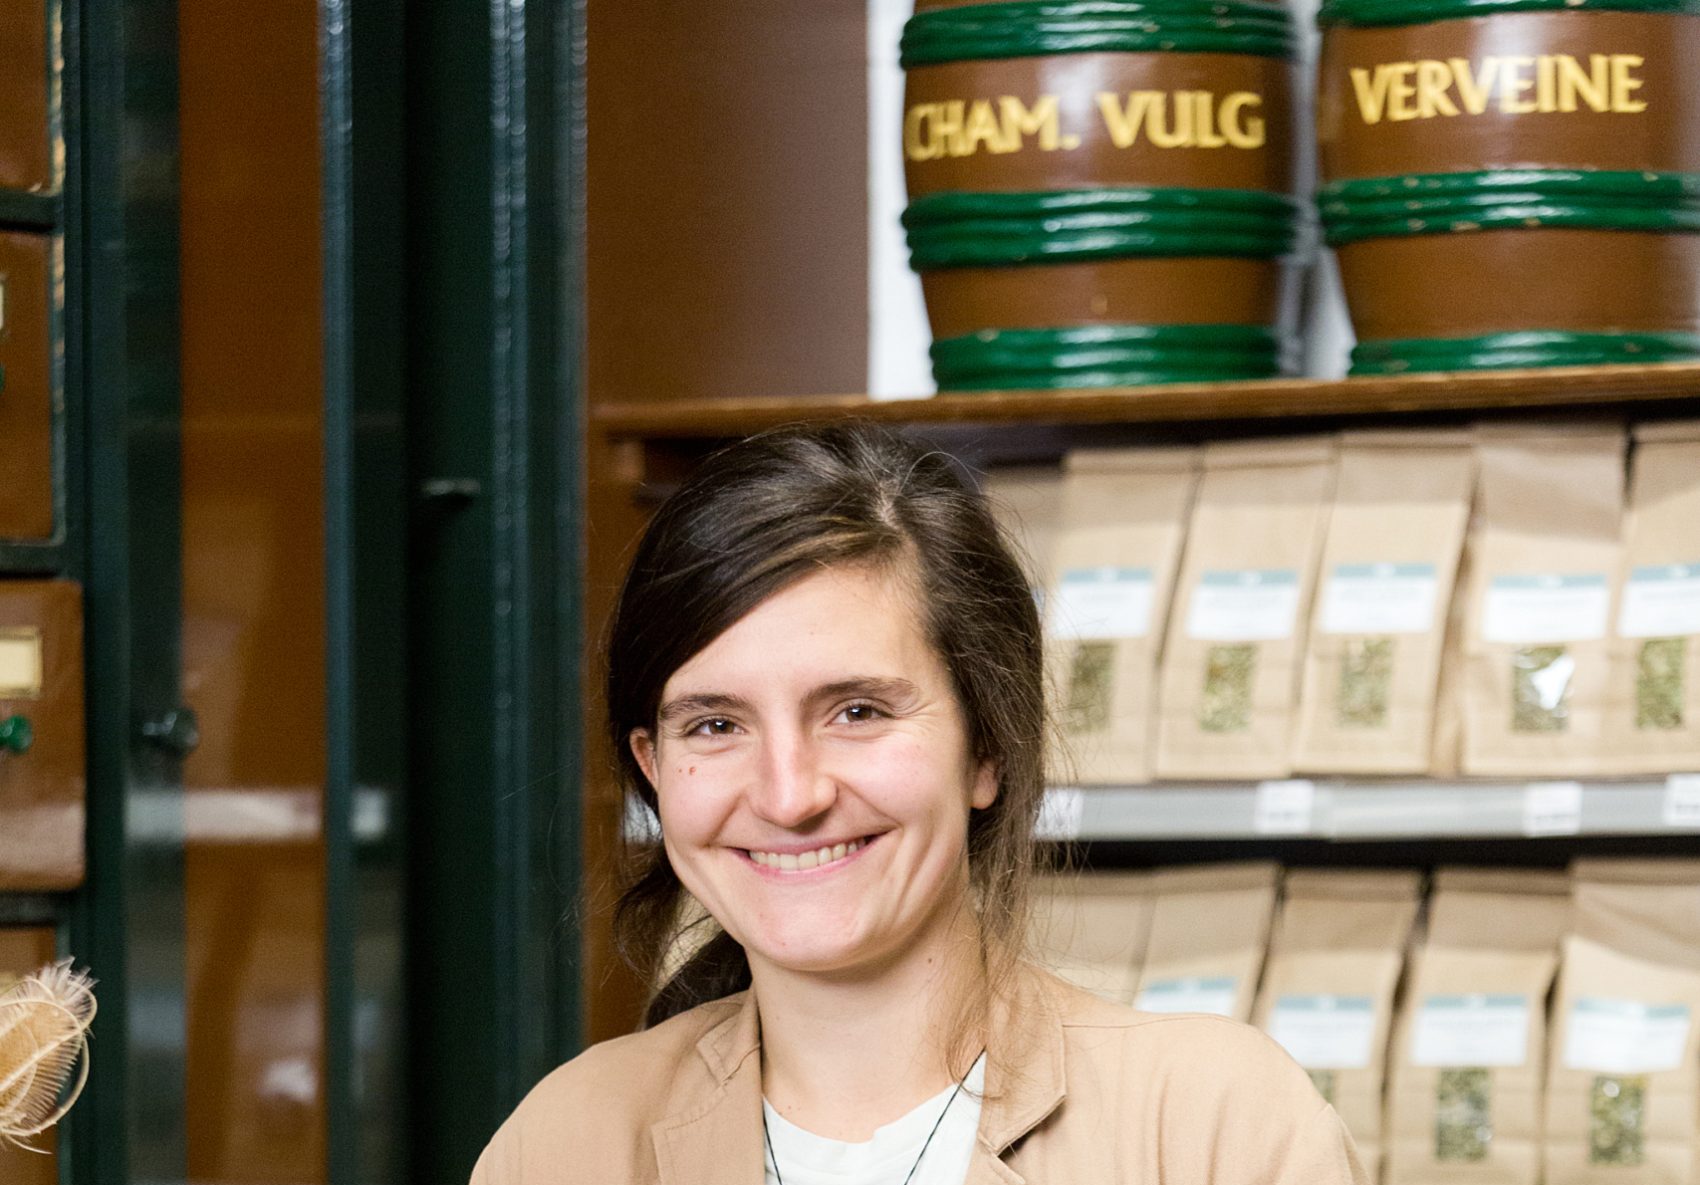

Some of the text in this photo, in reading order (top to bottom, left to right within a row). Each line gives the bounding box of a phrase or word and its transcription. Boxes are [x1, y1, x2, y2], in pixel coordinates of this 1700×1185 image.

[1350, 52, 1648, 124] VERVEINE
[906, 89, 1265, 160] CHAM. VULG
